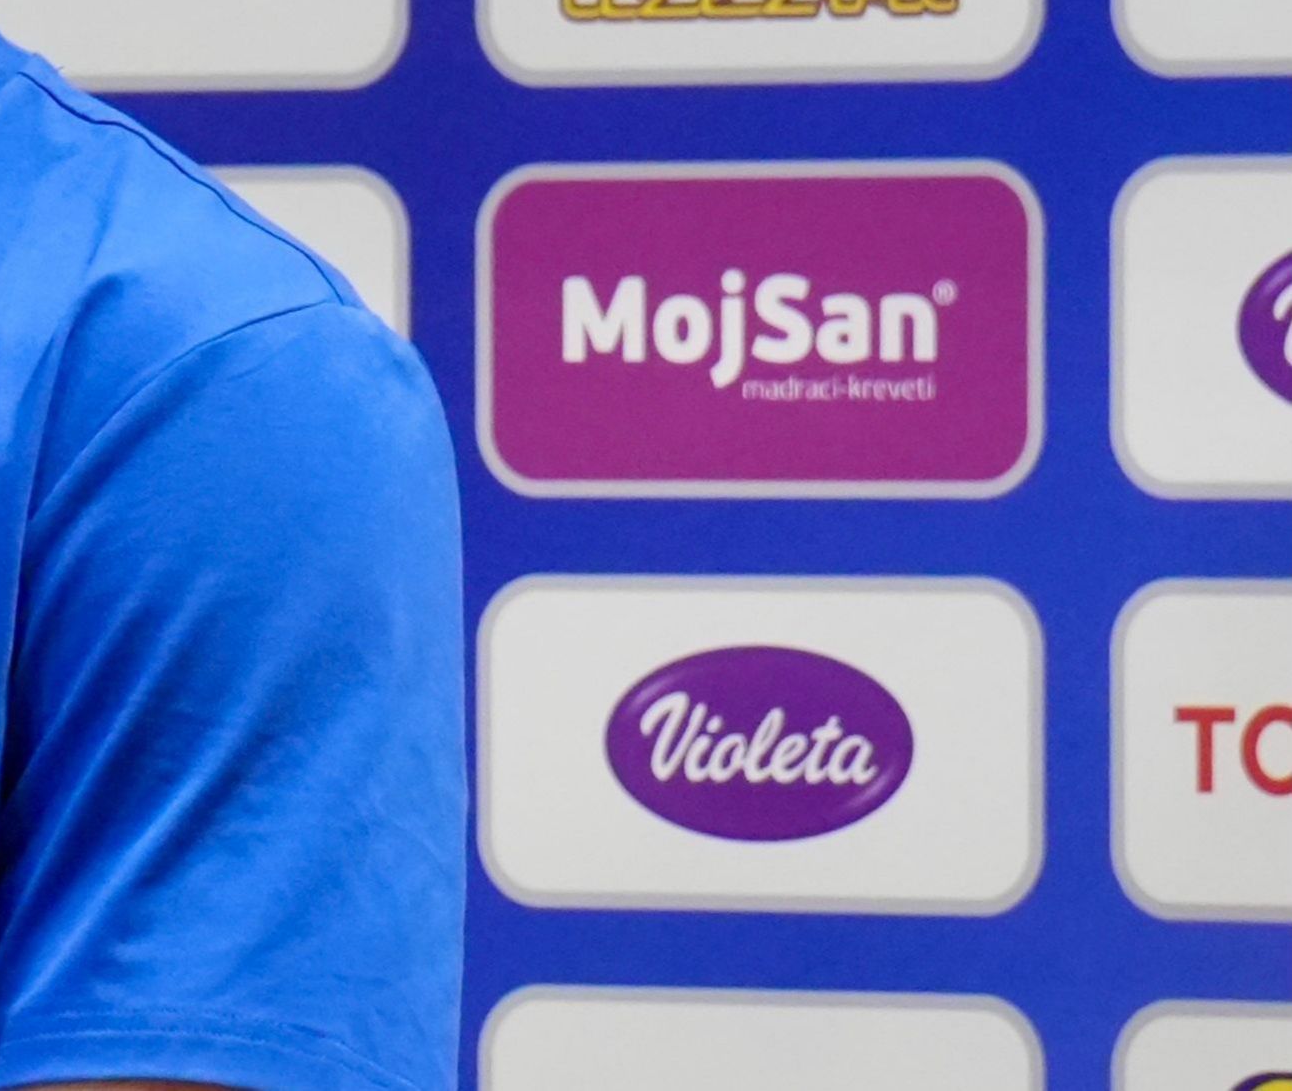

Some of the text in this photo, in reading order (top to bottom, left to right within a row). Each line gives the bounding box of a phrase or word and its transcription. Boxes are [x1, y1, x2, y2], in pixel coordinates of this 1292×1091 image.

[562, 267, 938, 389] MojSan
[743, 375, 935, 401] madraci-kreveti
[639, 691, 879, 784] Violeta
